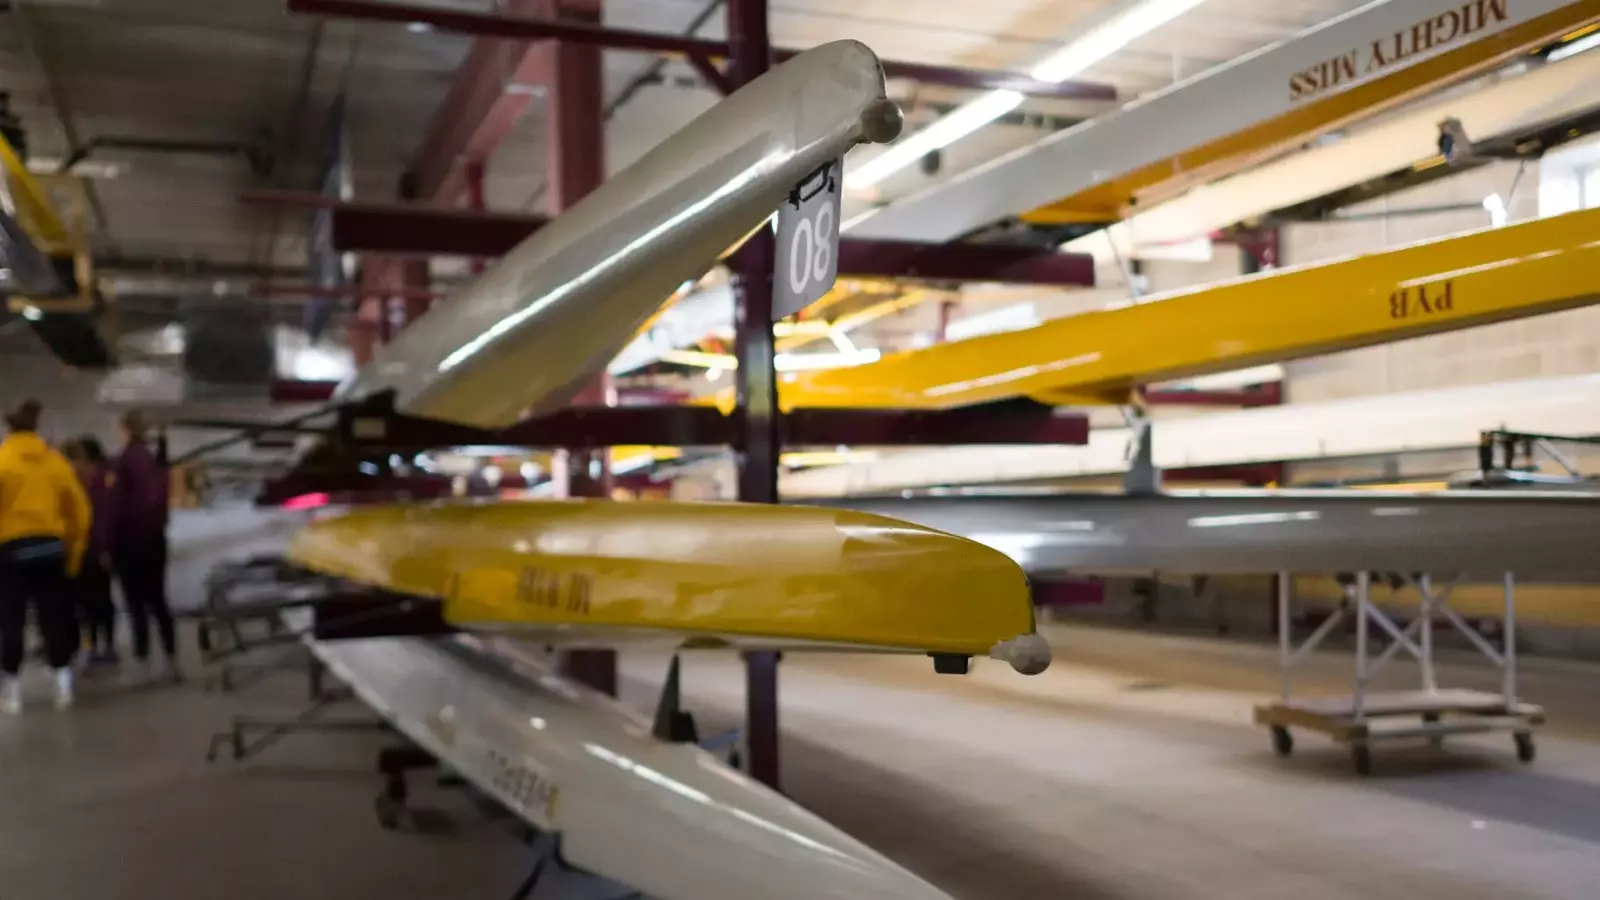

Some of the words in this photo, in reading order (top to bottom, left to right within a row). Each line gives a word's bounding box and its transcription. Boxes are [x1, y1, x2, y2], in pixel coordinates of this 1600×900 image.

[1365, 0, 1507, 72] MIGHTY
[1289, 48, 1358, 100] MISS
[1389, 281, 1452, 319] PYB
